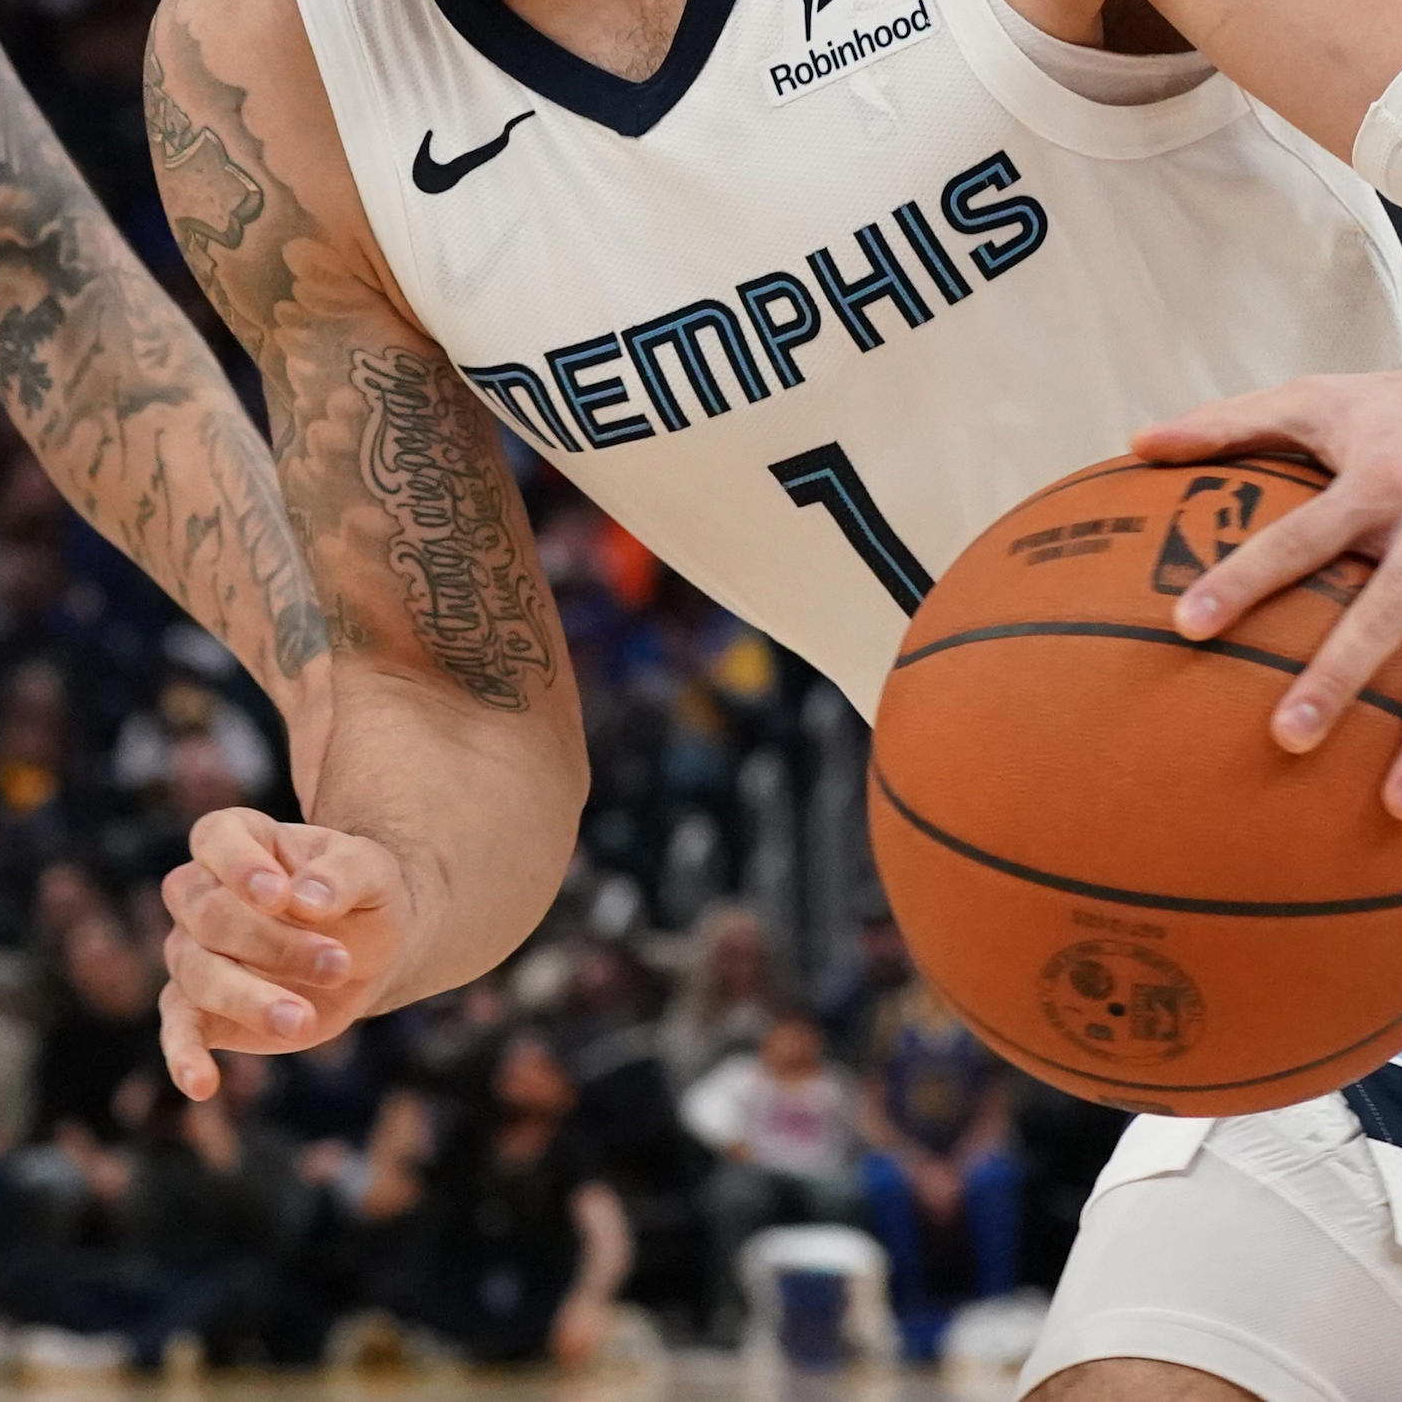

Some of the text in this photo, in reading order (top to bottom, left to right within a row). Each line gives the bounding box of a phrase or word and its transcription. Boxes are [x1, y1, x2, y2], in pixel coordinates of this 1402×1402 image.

[769, 0, 931, 96] Robinhood
[458, 150, 1048, 453] MEMPHIS
[767, 440, 936, 619] 1
